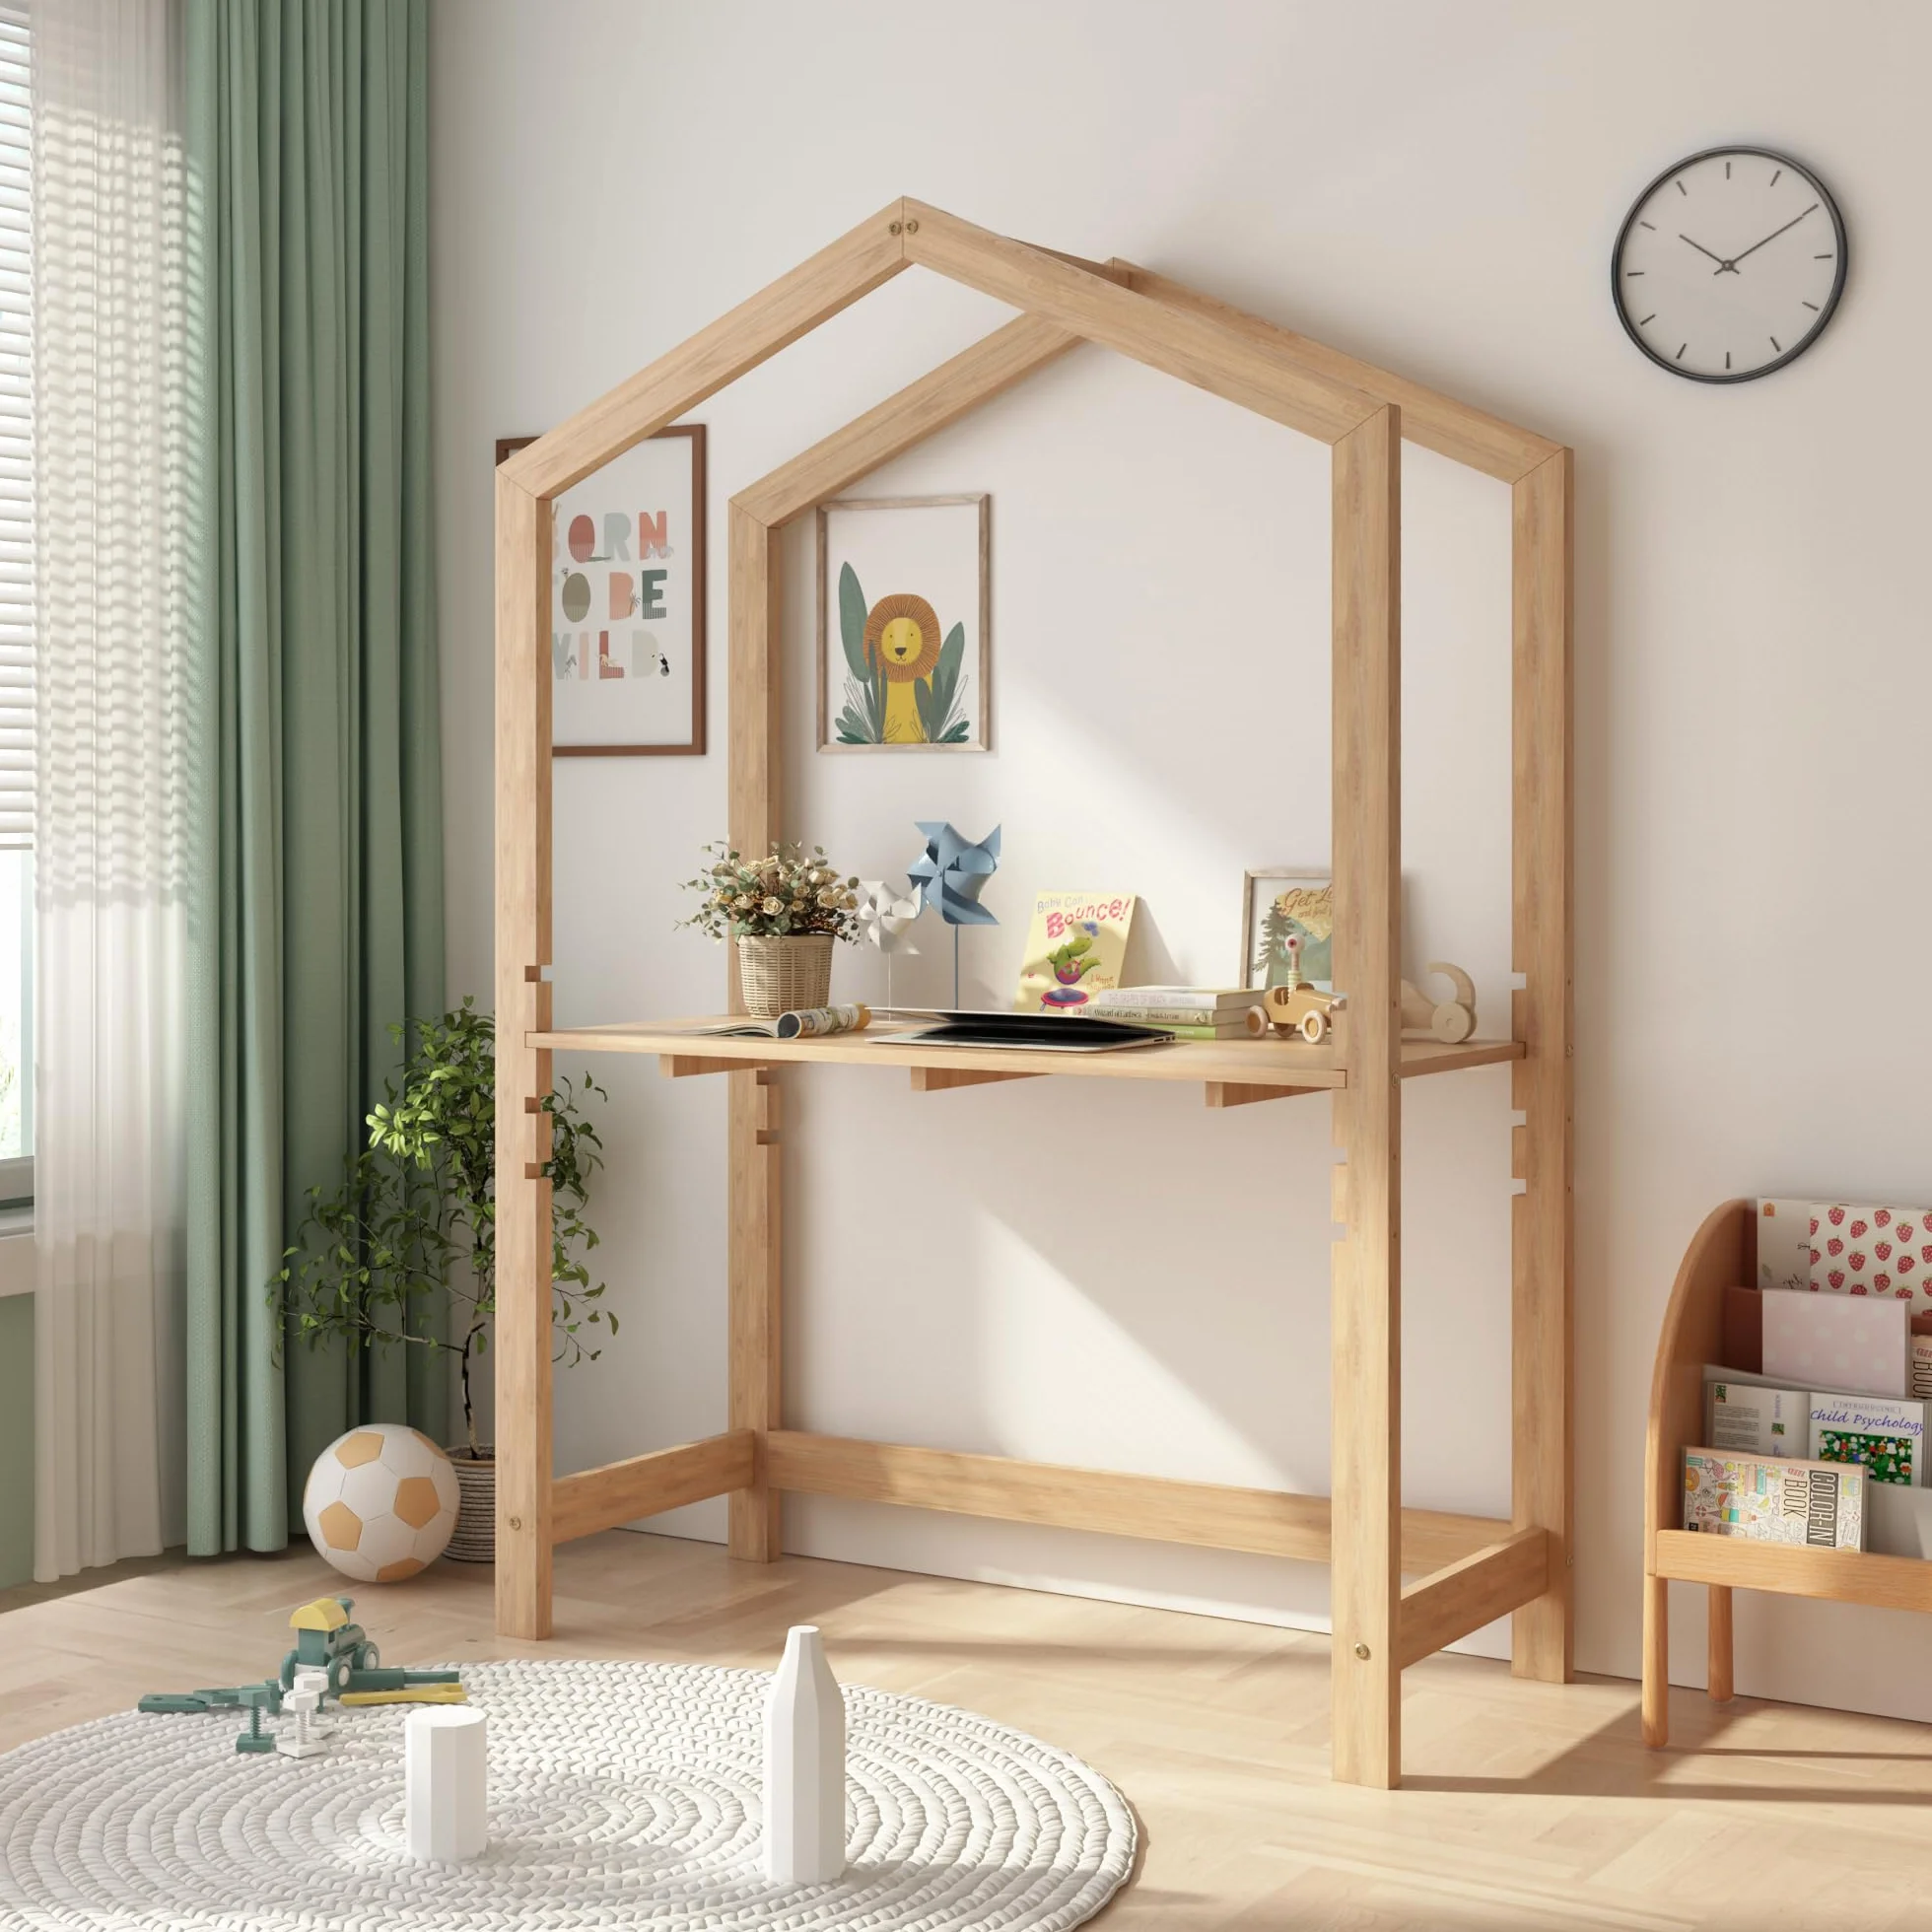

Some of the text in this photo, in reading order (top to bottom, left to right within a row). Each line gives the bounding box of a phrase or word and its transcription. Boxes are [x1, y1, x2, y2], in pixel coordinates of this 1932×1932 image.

[552, 511, 667, 563] ORN
[552, 570, 667, 623] O BE
[1037, 895, 1083, 914] Baby Can
[1046, 898, 1131, 938] Bounce!
[1285, 887, 1317, 916] Get
[1810, 1410, 1924, 1436] Child Psychology
[1783, 1479, 1808, 1519] BOOK
